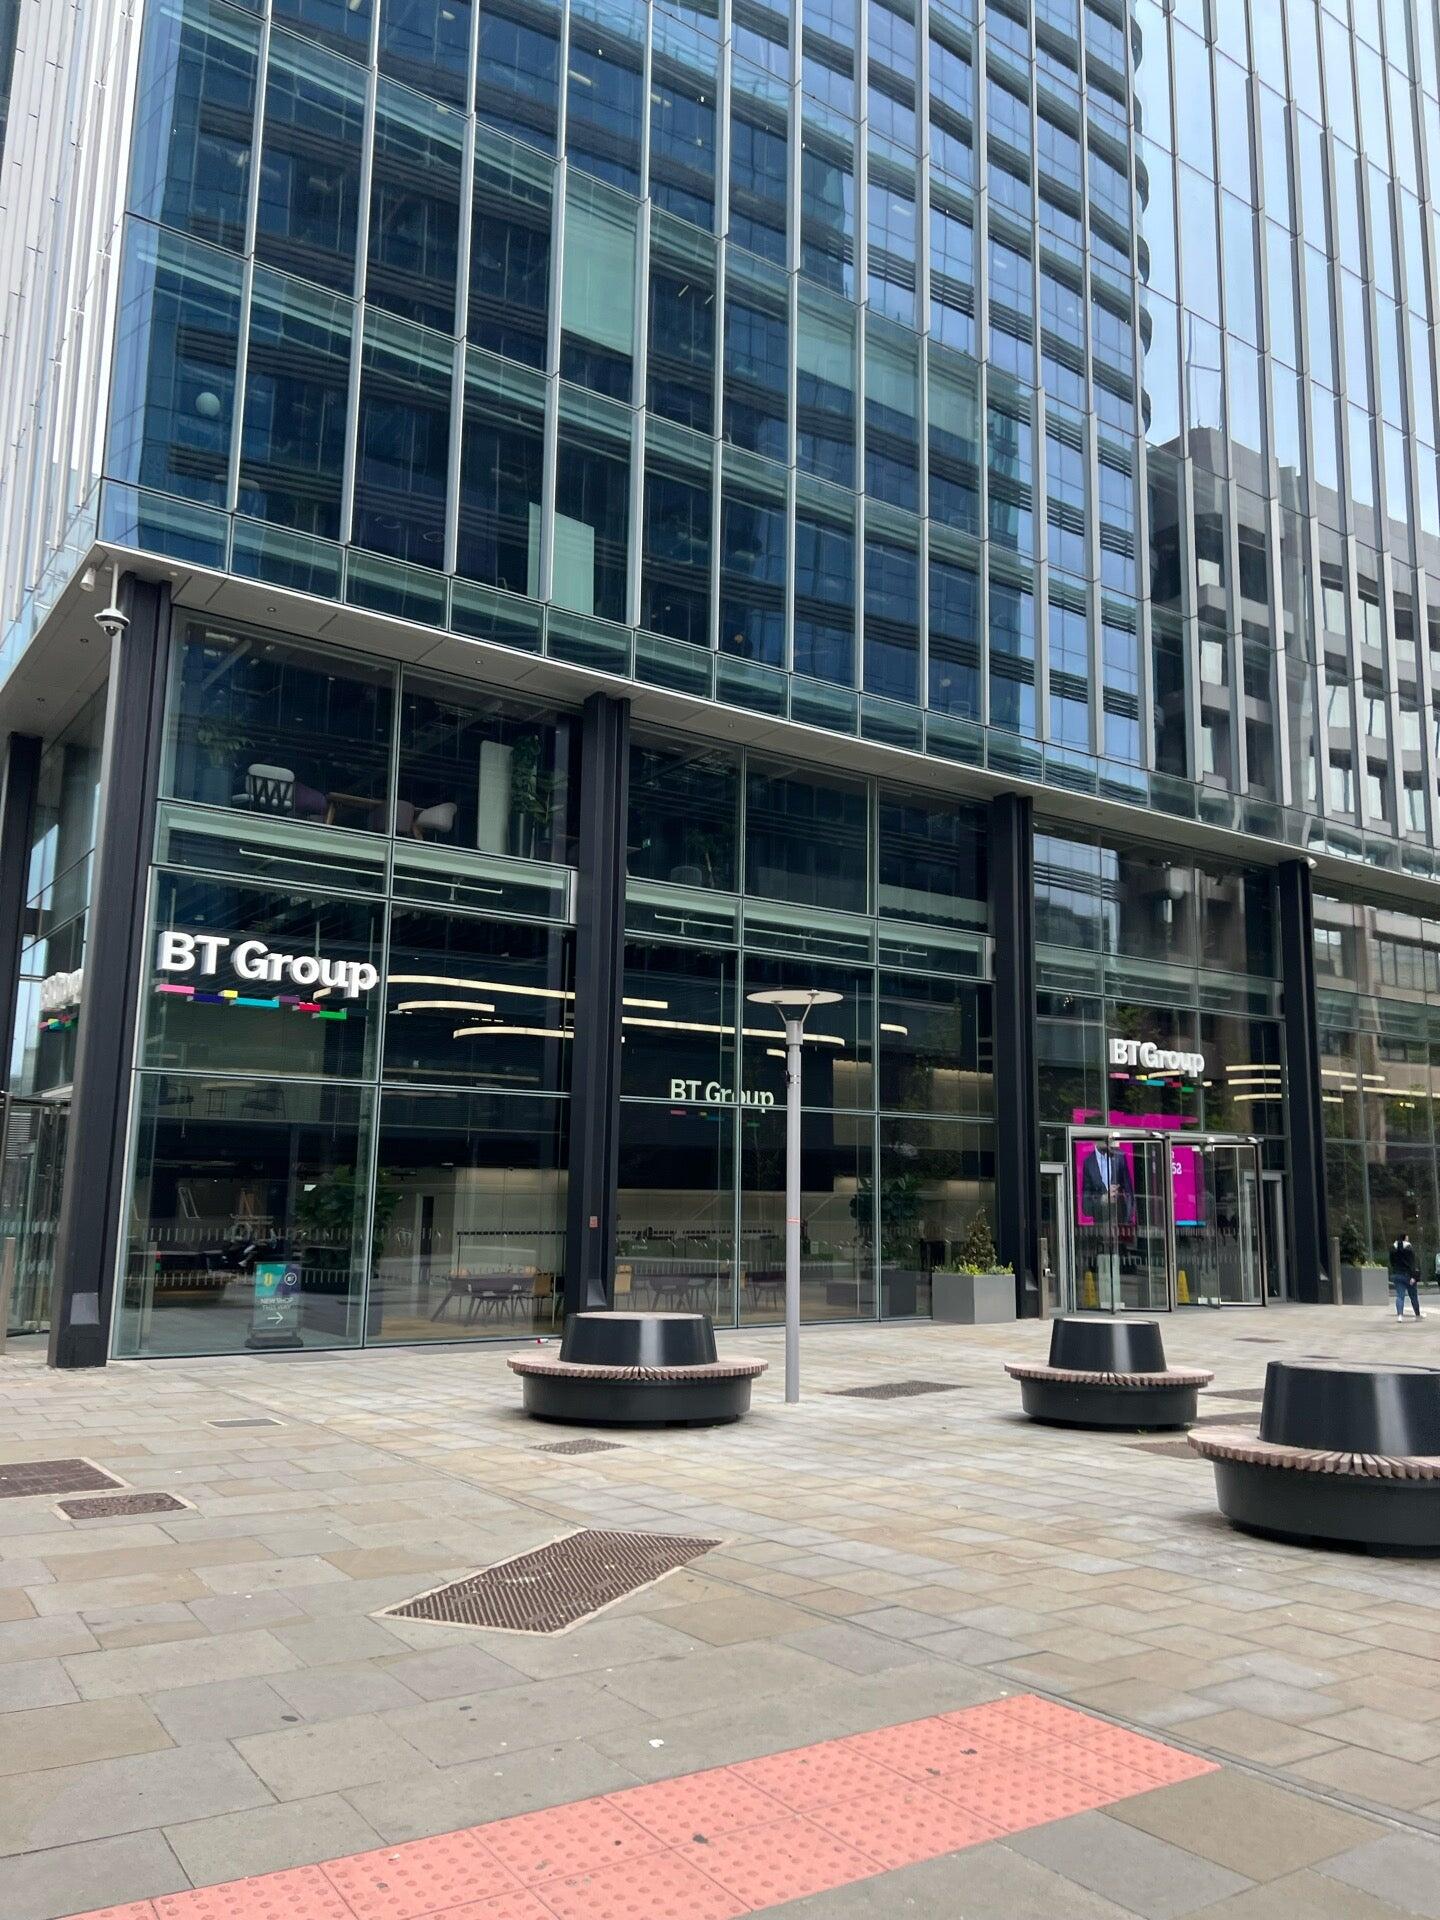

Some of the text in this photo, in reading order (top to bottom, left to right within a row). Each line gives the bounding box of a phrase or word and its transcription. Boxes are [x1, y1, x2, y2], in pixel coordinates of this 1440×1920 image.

[157, 931, 378, 999] BT Group
[1109, 1038, 1205, 1078] BT Group
[671, 1079, 702, 1101] BT
